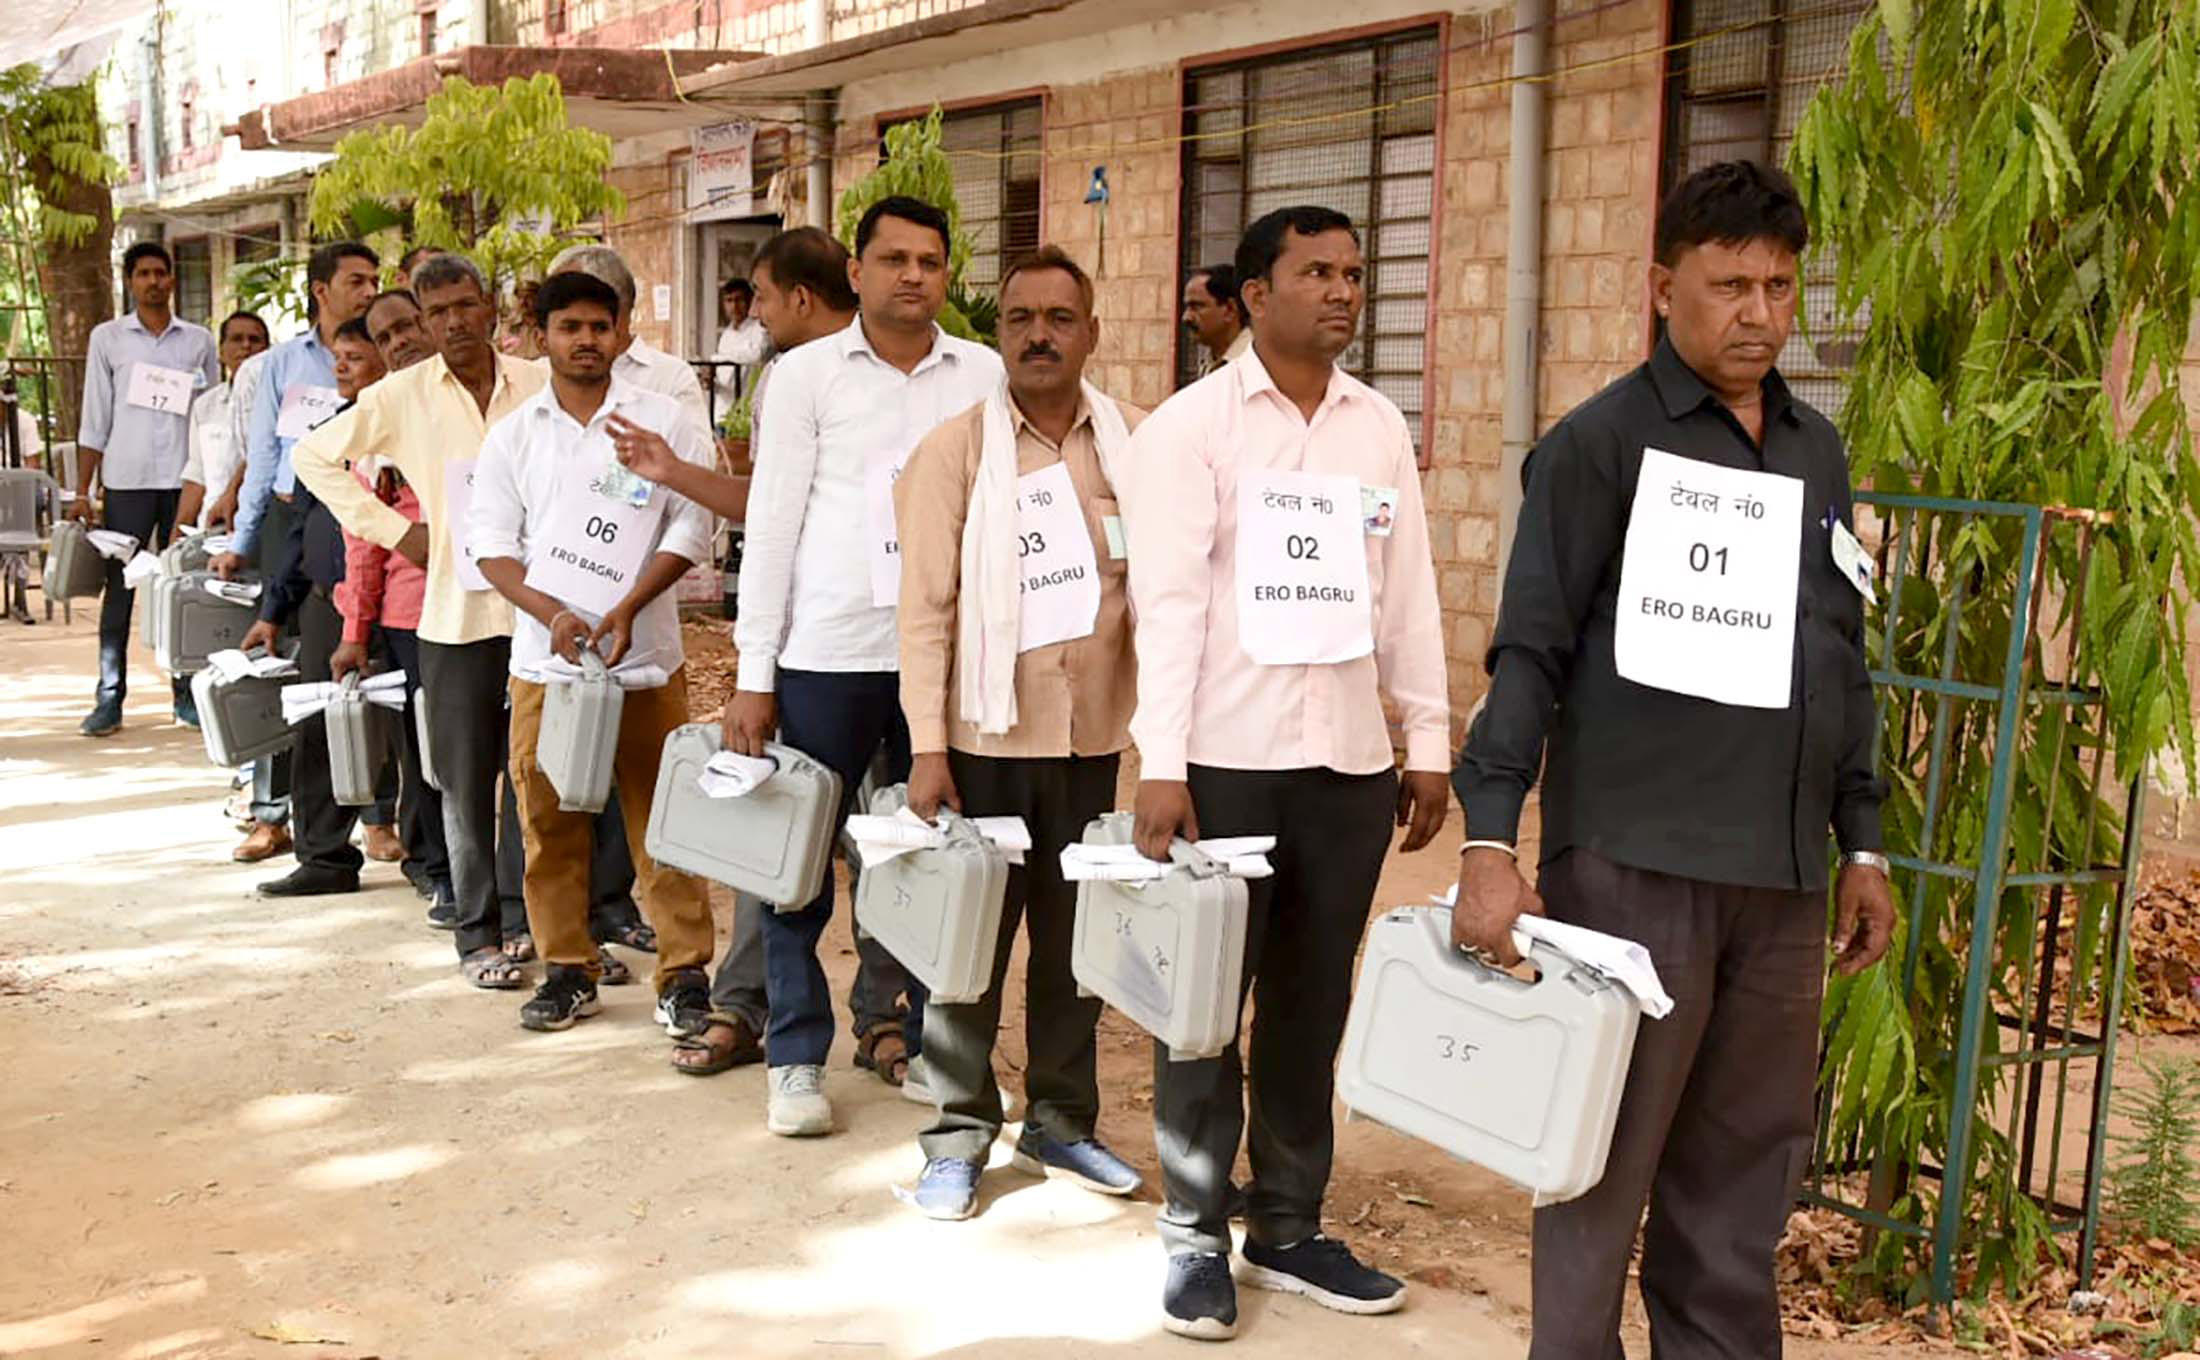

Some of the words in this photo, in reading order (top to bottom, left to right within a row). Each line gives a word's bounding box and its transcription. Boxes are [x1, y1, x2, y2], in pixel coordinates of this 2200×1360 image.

[151, 395, 169, 409] 17
[586, 516, 618, 544] 06
[1287, 535, 1320, 560] 02
[1689, 543, 1729, 576] 01
[551, 546, 578, 564] ERO
[579, 557, 624, 583] BAGRU
[1029, 565, 1085, 591] BAGRU
[1255, 586, 1290, 601] ERO
[1296, 586, 1355, 602] BAGRU
[1641, 597, 1684, 619] ERO
[1692, 605, 1772, 629] BAGRU
[1436, 1035, 1480, 1062] 35
